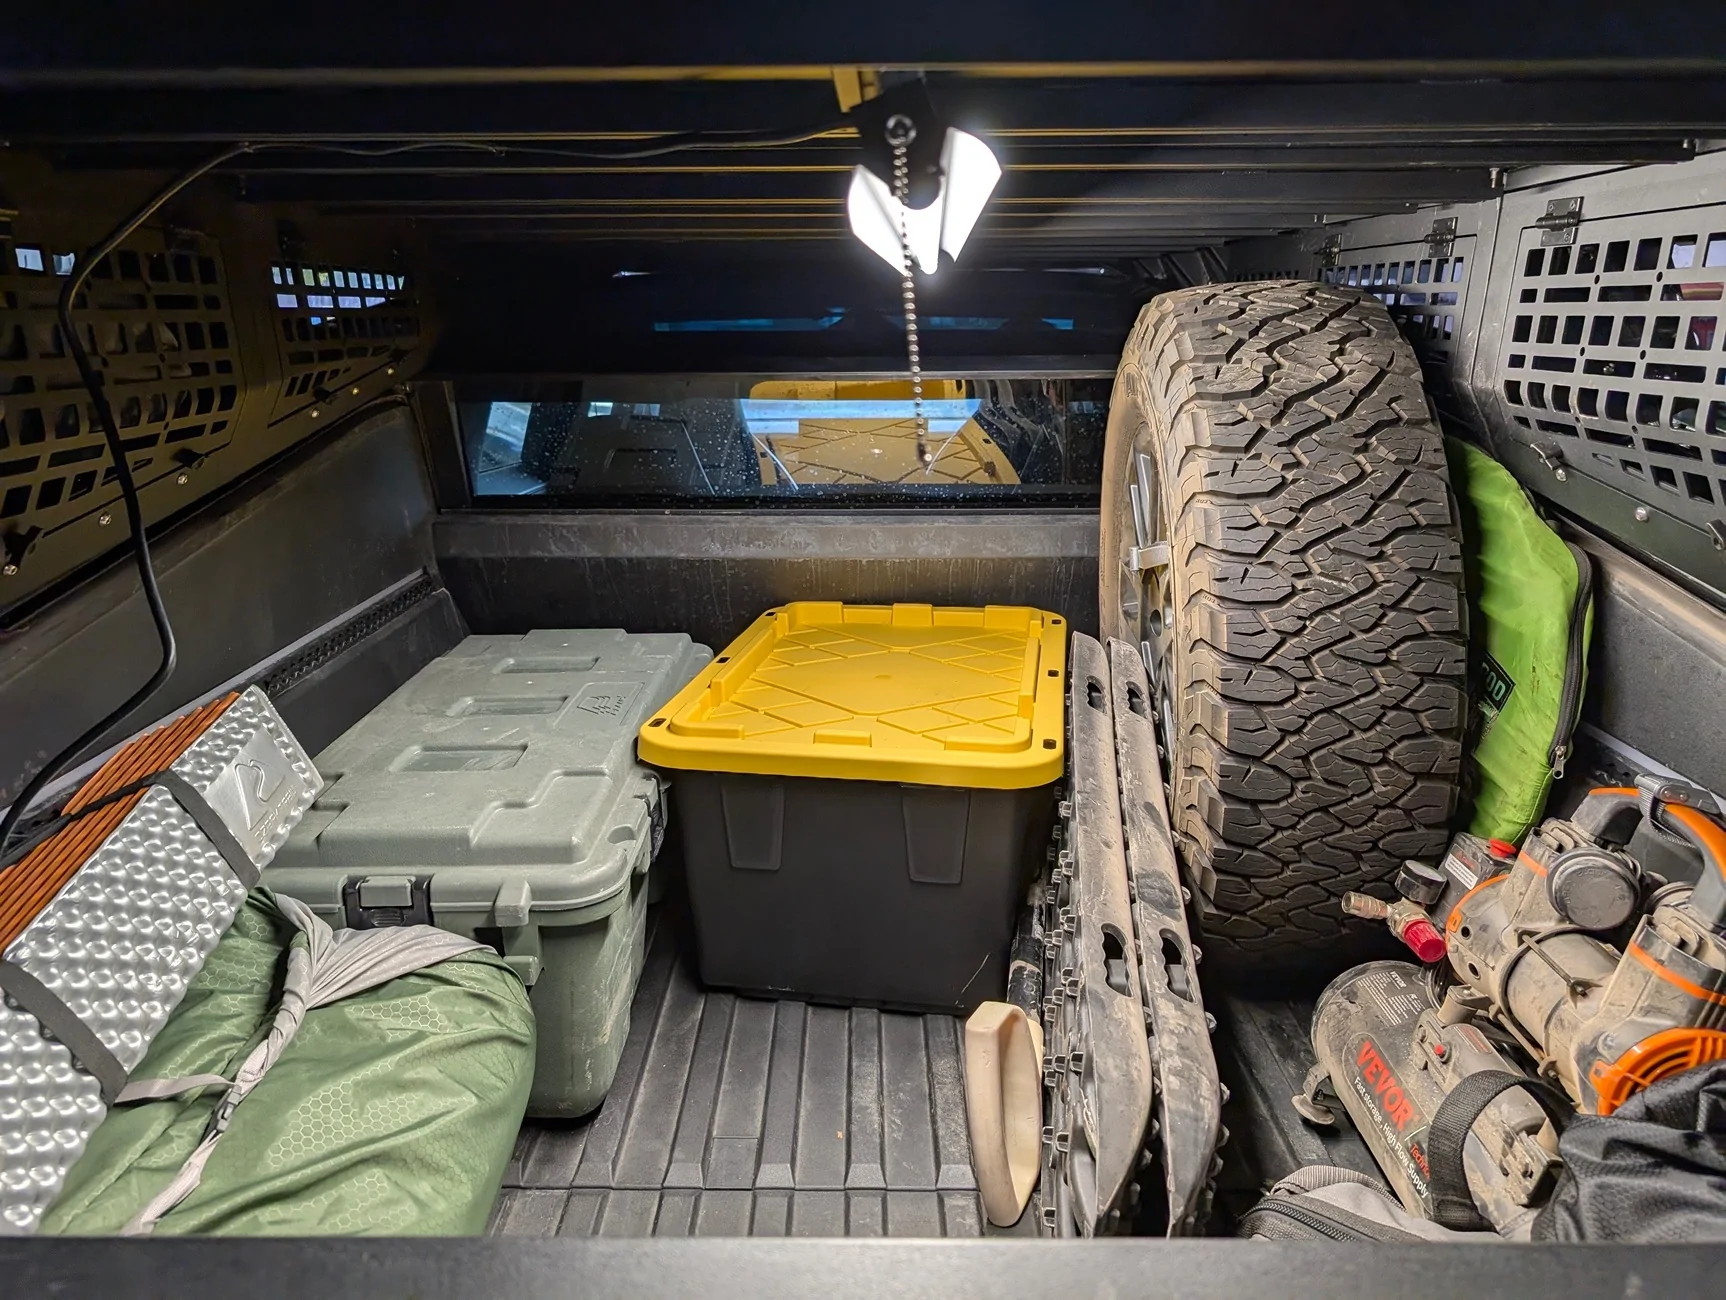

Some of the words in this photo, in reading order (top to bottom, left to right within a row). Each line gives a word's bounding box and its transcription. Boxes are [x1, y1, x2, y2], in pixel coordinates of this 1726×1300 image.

[1354, 1076, 1366, 1097] Fast
[1394, 1142, 1410, 1167] Flow
[1408, 1163, 1430, 1199] Supply
[1357, 1040, 1414, 1131] VEVOR
